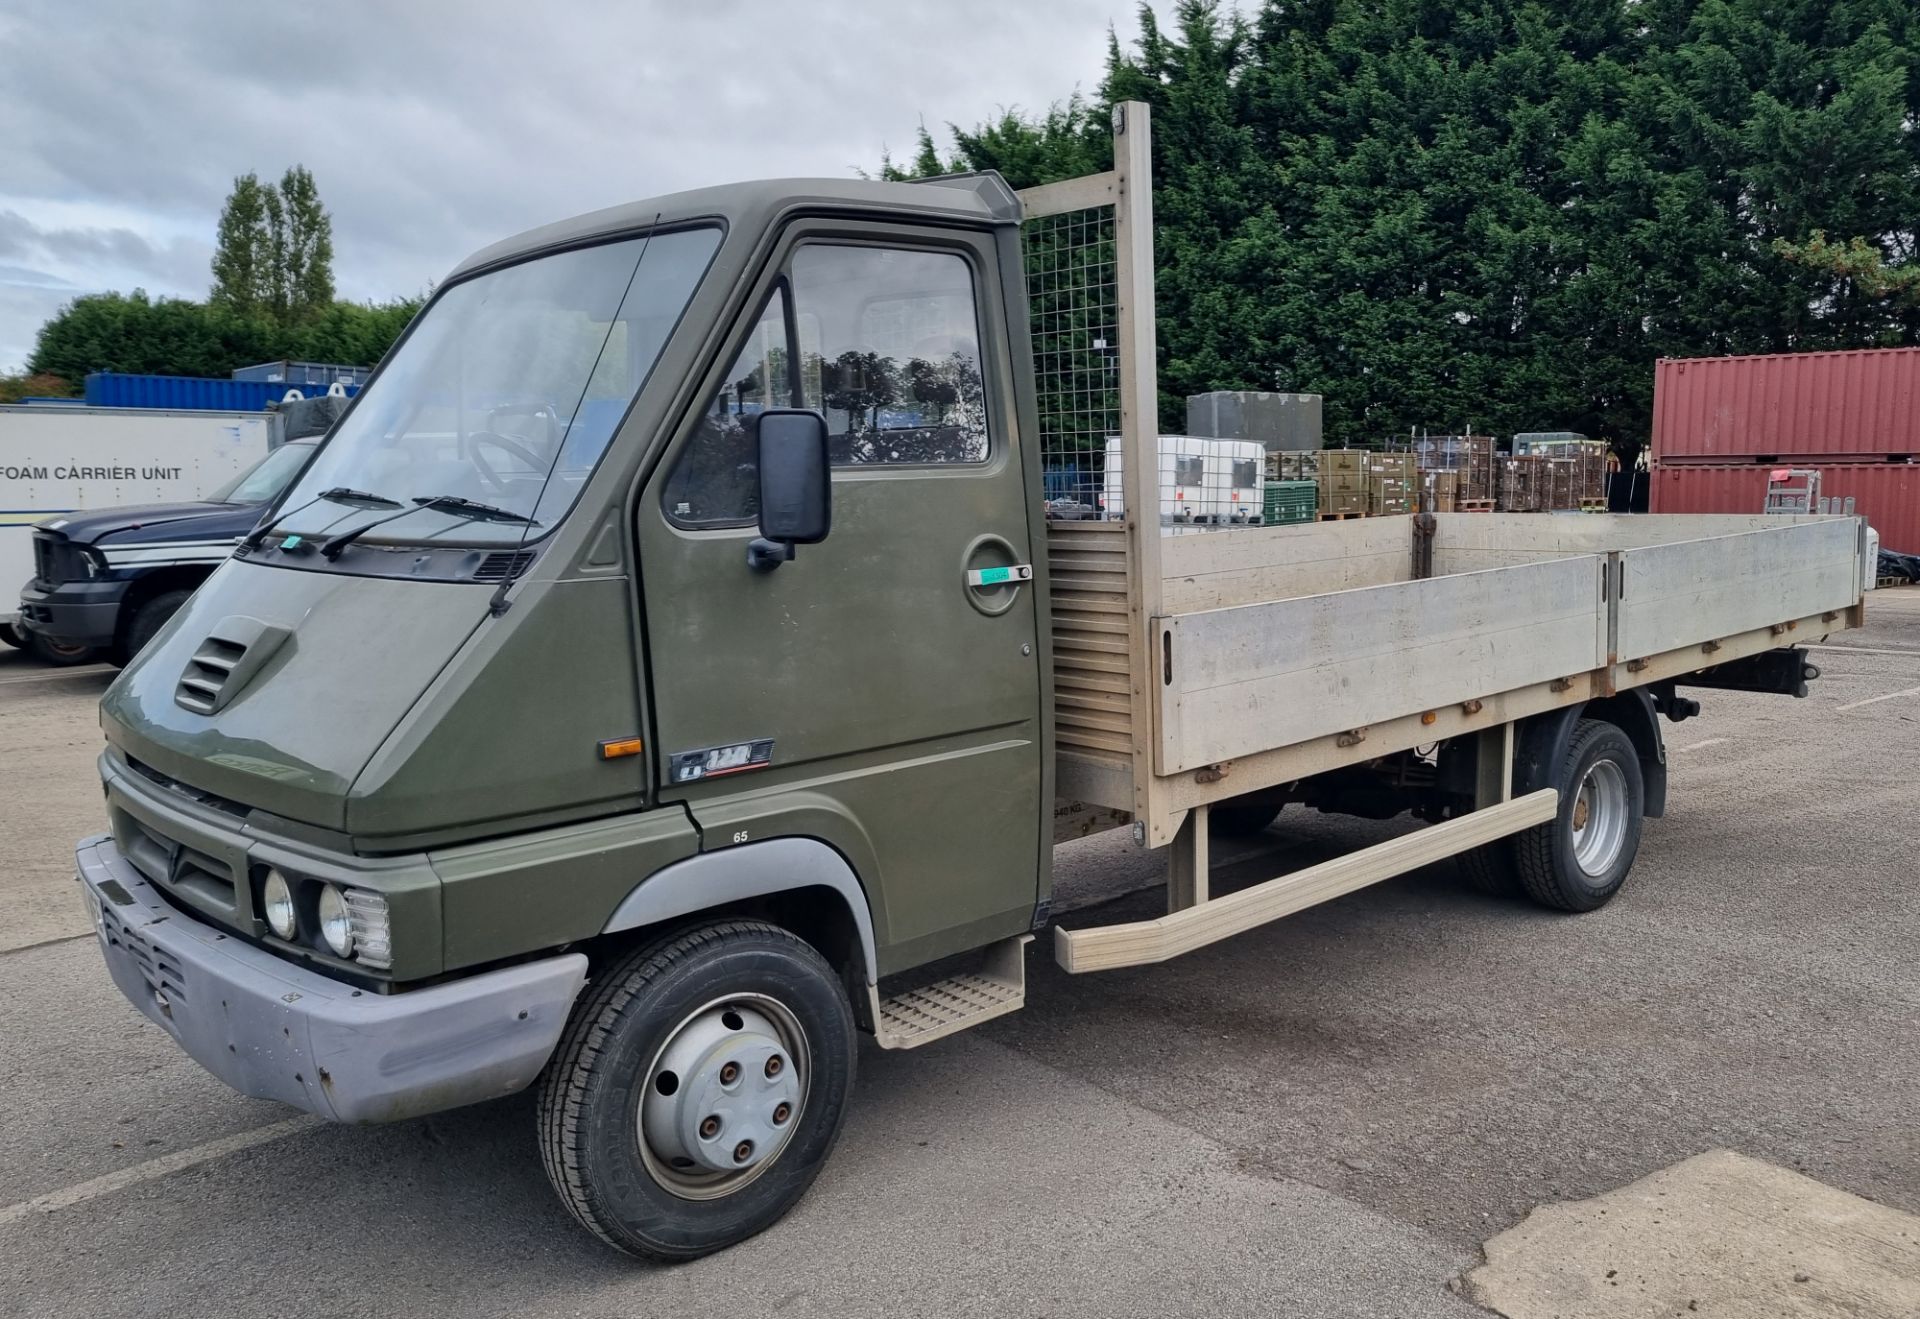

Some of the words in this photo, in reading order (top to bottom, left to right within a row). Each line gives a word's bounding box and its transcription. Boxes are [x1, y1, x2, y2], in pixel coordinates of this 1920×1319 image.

[54, 466, 136, 480] CARRIER
[142, 467, 182, 480] UNIT
[733, 830, 748, 843] 65
